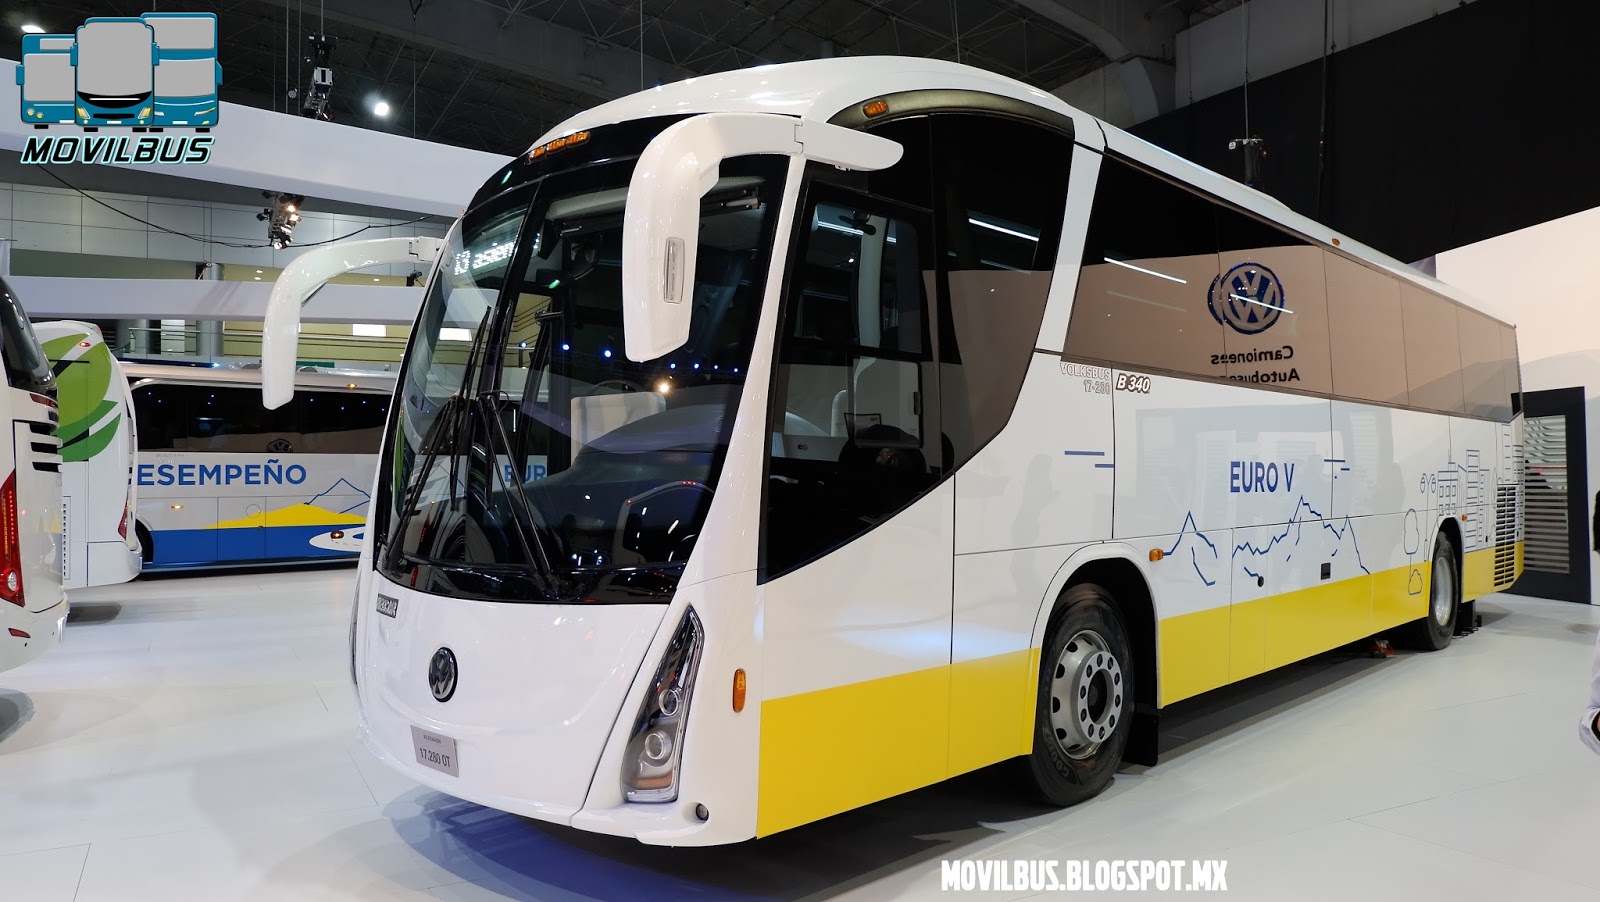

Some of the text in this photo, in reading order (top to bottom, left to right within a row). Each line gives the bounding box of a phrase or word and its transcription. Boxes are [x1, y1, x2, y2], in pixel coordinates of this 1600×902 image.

[1060, 362, 1111, 381] VOLKSBUS
[1083, 379, 1111, 395] 17-280
[1127, 375, 1151, 394] 340
[1230, 461, 1295, 493] EURO V
[419, 748, 441, 765] 17.280
